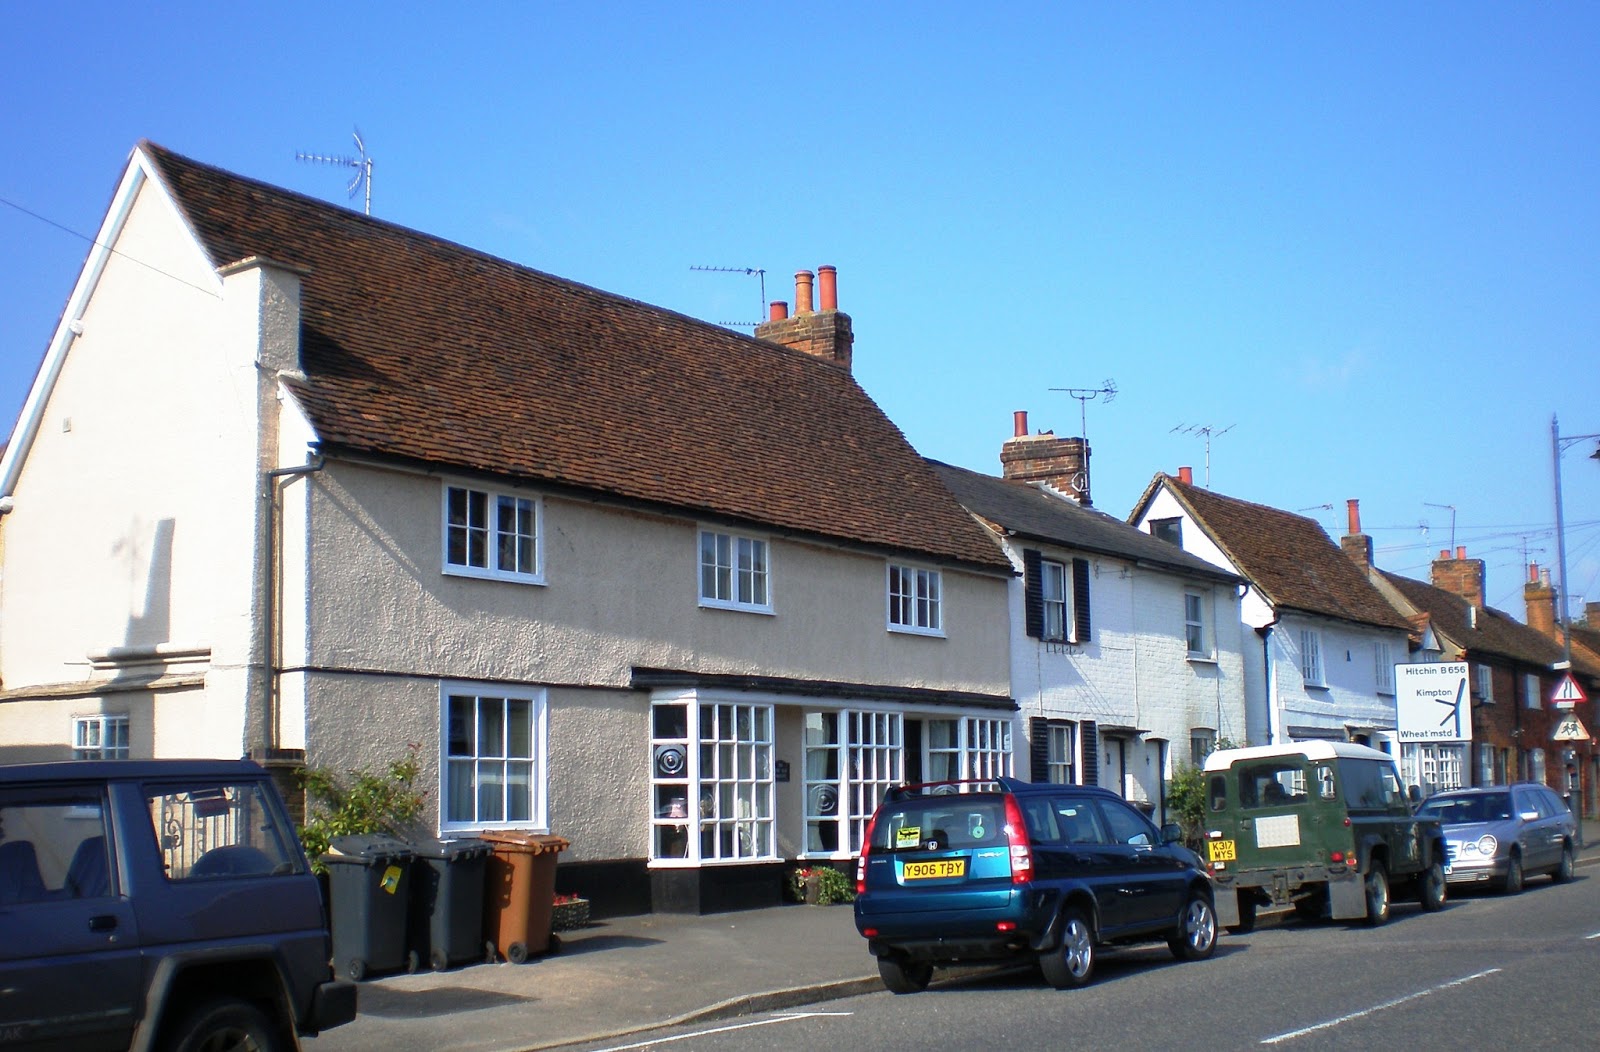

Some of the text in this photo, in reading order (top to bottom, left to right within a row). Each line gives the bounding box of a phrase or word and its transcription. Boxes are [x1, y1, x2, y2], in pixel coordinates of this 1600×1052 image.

[1405, 667, 1437, 675] Hitchin
[1416, 689, 1453, 698] Kimpton
[1213, 841, 1233, 850] K317
[1214, 850, 1233, 859] MYS
[906, 863, 962, 877] Y906 TBY
